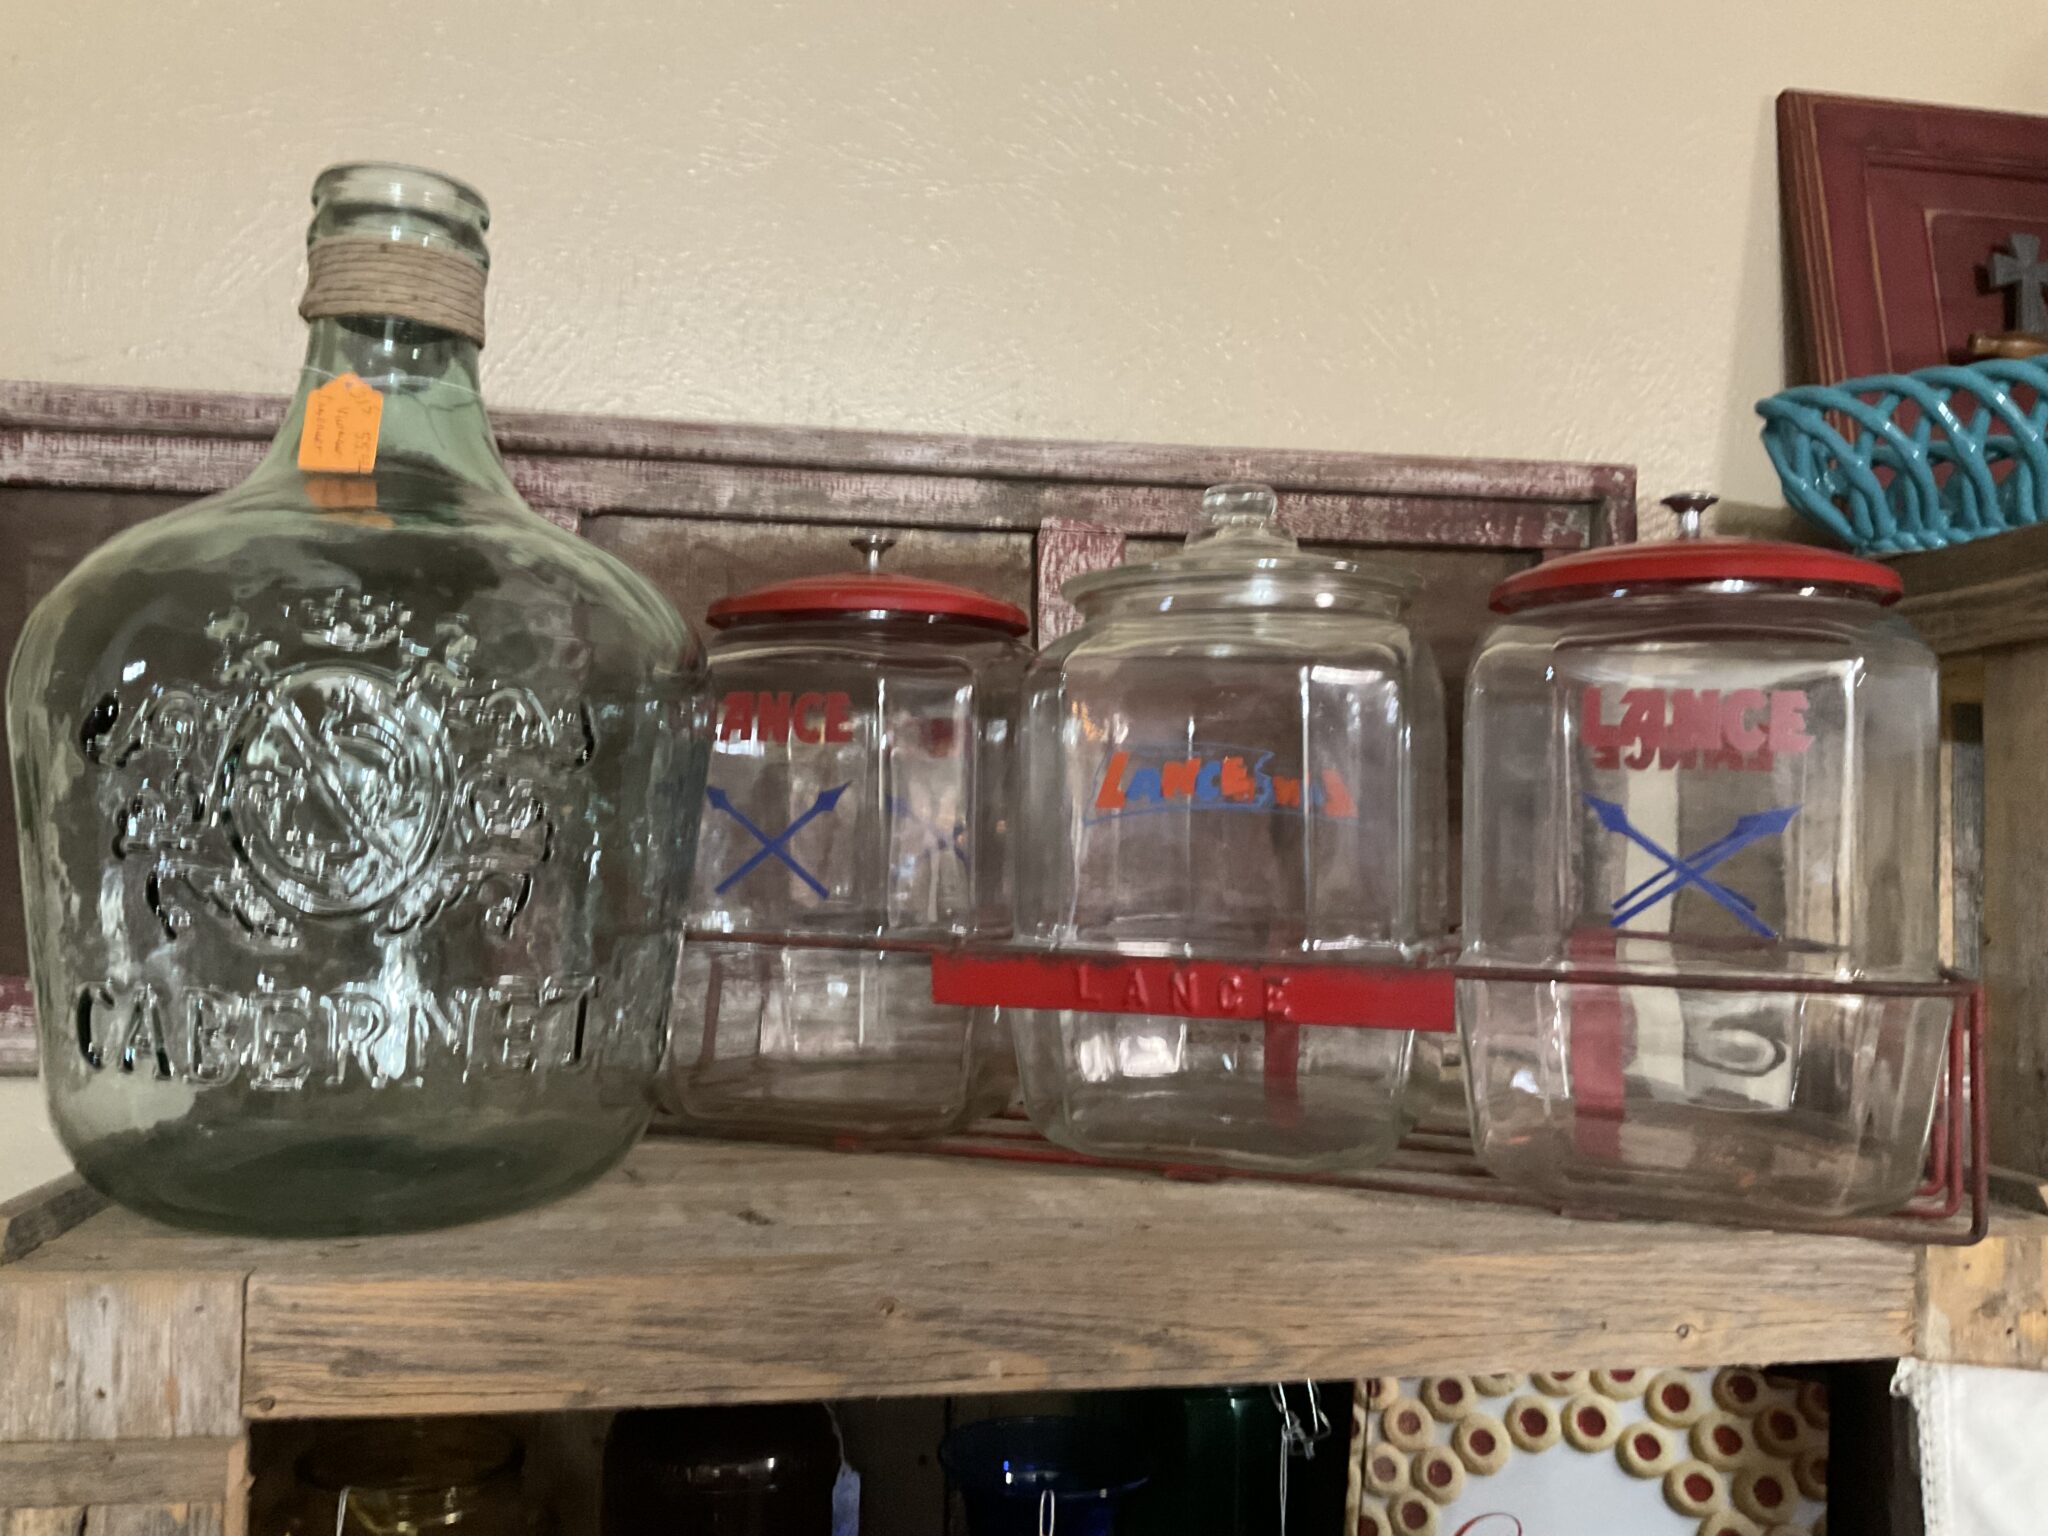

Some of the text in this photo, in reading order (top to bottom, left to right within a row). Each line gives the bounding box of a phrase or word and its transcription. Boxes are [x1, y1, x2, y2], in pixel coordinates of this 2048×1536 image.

[716, 691, 854, 746] ANCE
[1581, 688, 1815, 752] LANCE
[1077, 965, 1293, 1020] LANCE
[76, 975, 598, 1090] CABERNET
